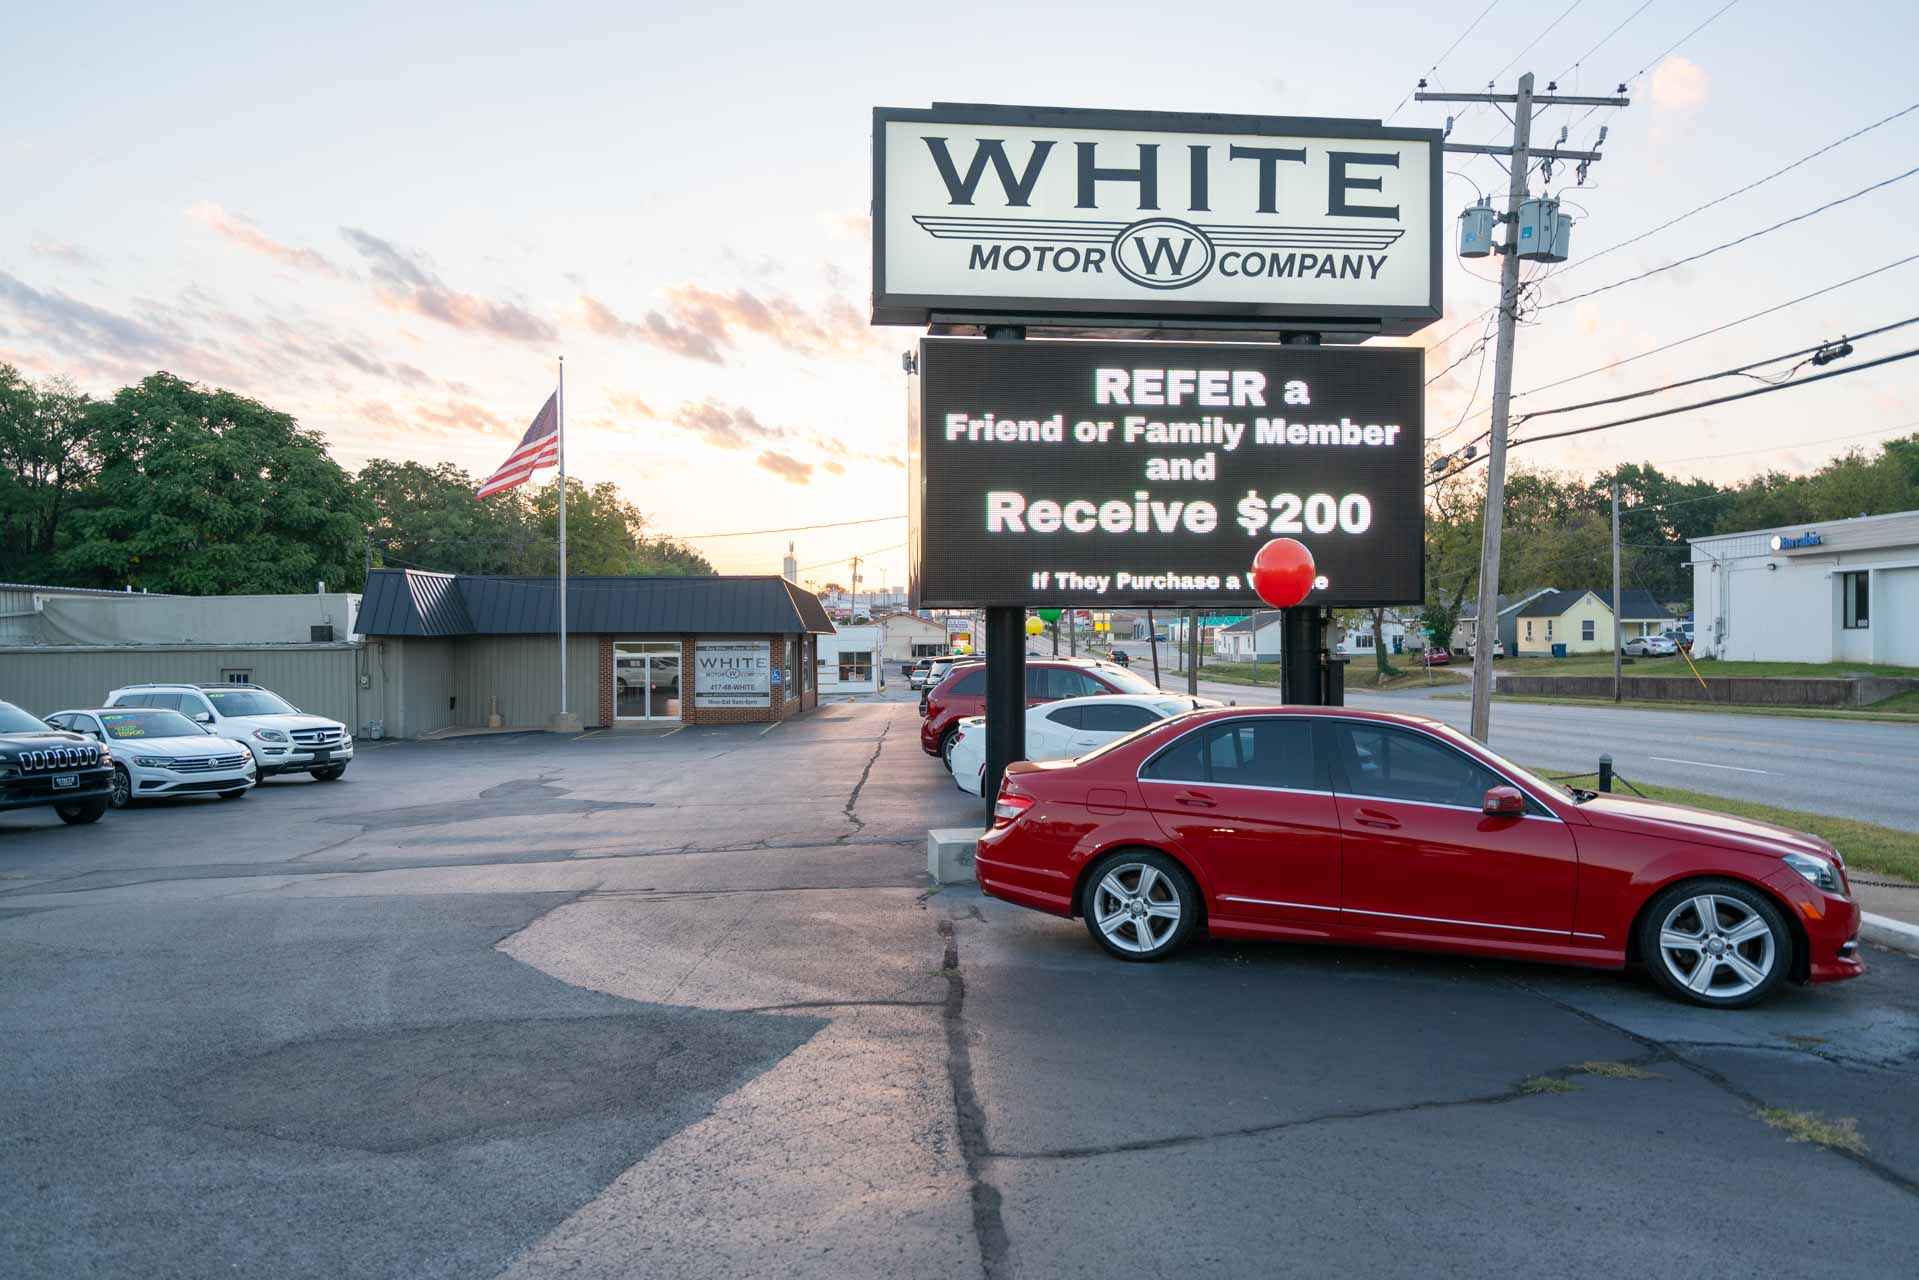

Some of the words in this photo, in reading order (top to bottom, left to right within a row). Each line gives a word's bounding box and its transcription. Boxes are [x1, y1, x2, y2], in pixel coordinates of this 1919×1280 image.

[920, 137, 1401, 222] WHITE
[968, 245, 1106, 274] MOTOR
[1218, 251, 1388, 280] COMPANY
[1095, 368, 1267, 406] REFER
[1283, 380, 1311, 405] a
[945, 413, 1063, 443] Friend
[1074, 421, 1114, 443] or
[1123, 415, 1246, 452] Family
[1254, 417, 1401, 446] Member
[1144, 452, 1216, 481] and
[985, 490, 1218, 534] Receive
[1236, 489, 1372, 537] $200
[1031, 571, 1049, 590] If
[1053, 571, 1111, 594] They
[1116, 571, 1221, 590] Purchase
[1225, 575, 1242, 590] a
[700, 657, 767, 669] WHITE
